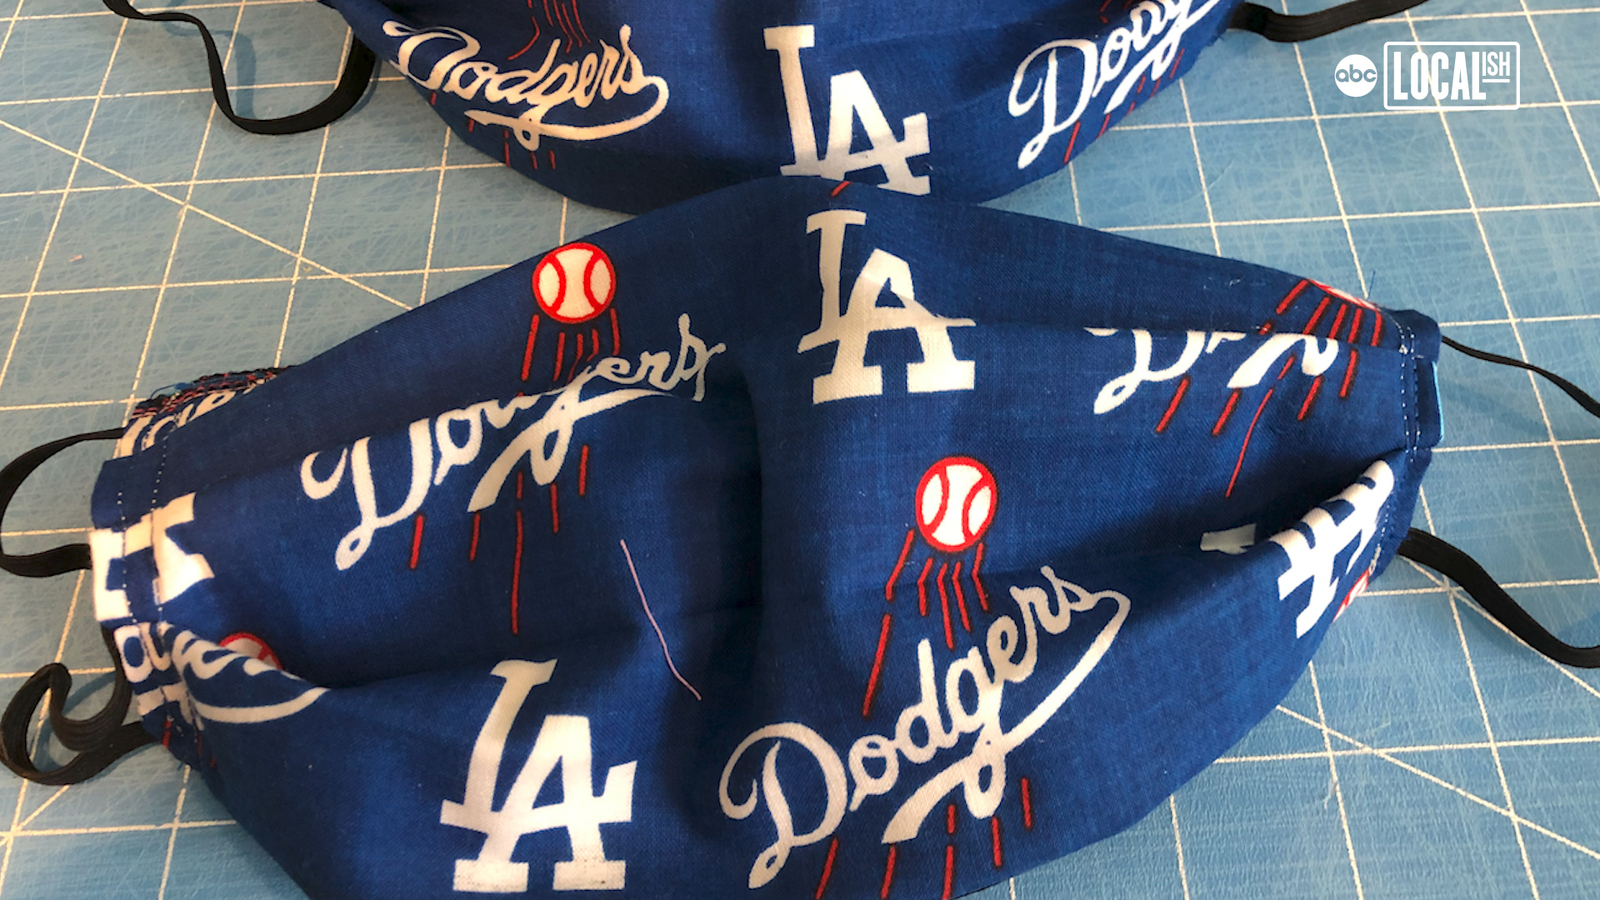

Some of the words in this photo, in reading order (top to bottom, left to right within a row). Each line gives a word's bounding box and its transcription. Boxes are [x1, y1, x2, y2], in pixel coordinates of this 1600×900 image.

[382, 24, 669, 150] Dodgers
[763, 24, 931, 196] LA
[797, 209, 976, 404] LA
[440, 658, 637, 892] LA
[719, 566, 1130, 889] Dodgers
